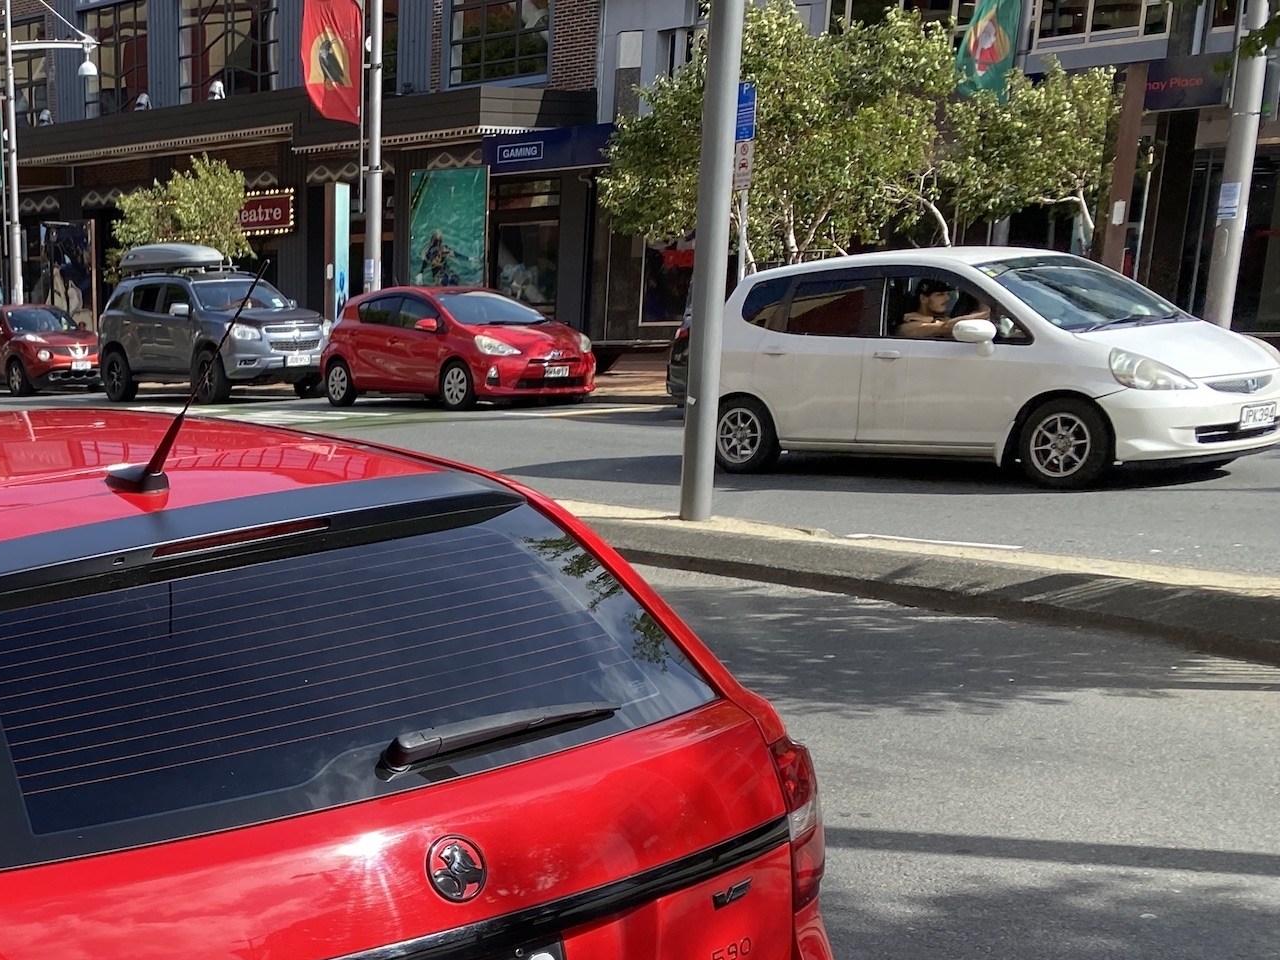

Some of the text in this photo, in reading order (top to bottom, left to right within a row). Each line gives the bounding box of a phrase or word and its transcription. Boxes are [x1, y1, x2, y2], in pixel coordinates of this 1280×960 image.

[1145, 76, 1204, 91] nay Place
[502, 146, 538, 159] GAMING
[1241, 405, 1275, 424] JPK394
